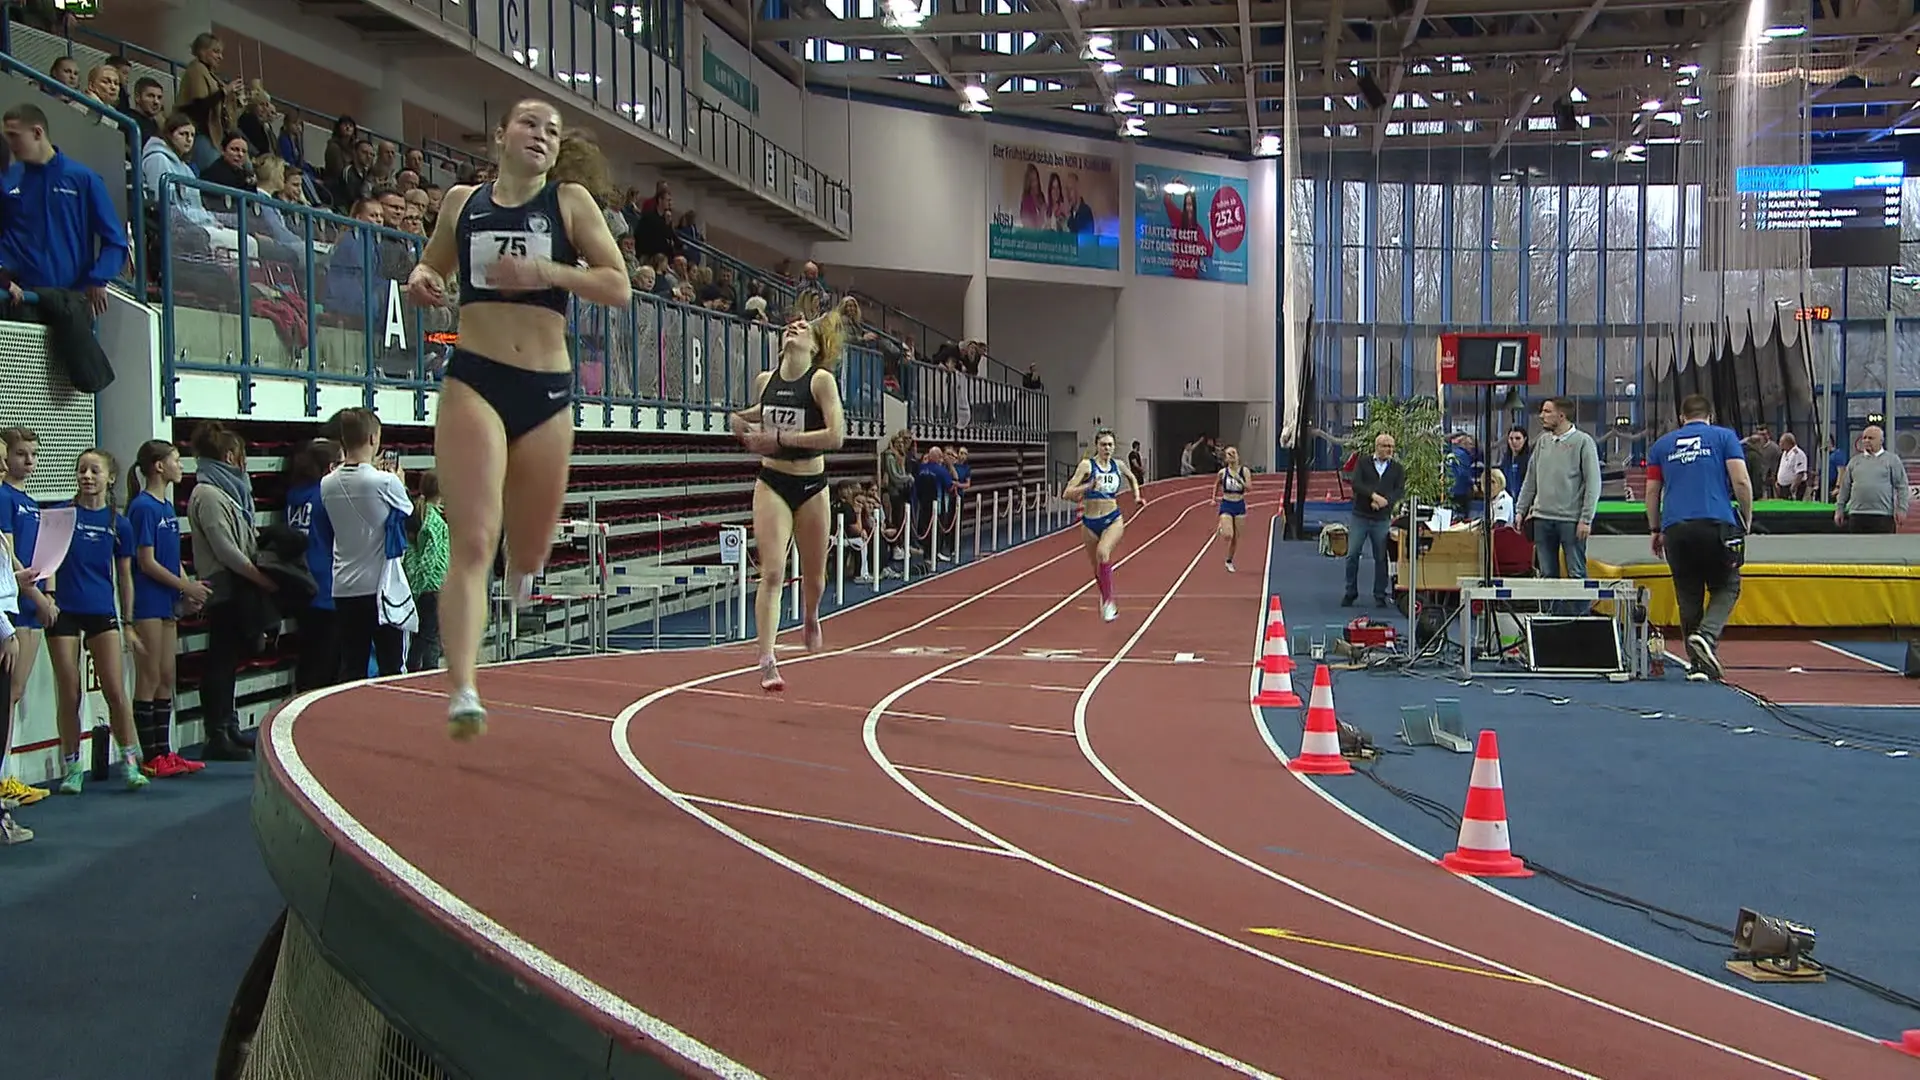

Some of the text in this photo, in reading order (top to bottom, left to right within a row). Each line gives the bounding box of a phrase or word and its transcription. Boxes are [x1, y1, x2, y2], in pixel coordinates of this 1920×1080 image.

[507, 0, 519, 45] C
[654, 86, 663, 123] D
[1215, 209, 1234, 228] 252
[493, 235, 527, 257] 75
[384, 278, 407, 350] A
[692, 336, 702, 385] B
[1494, 341, 1522, 378] 0
[770, 408, 796, 425] 172
[1103, 475, 1114, 484] 10
